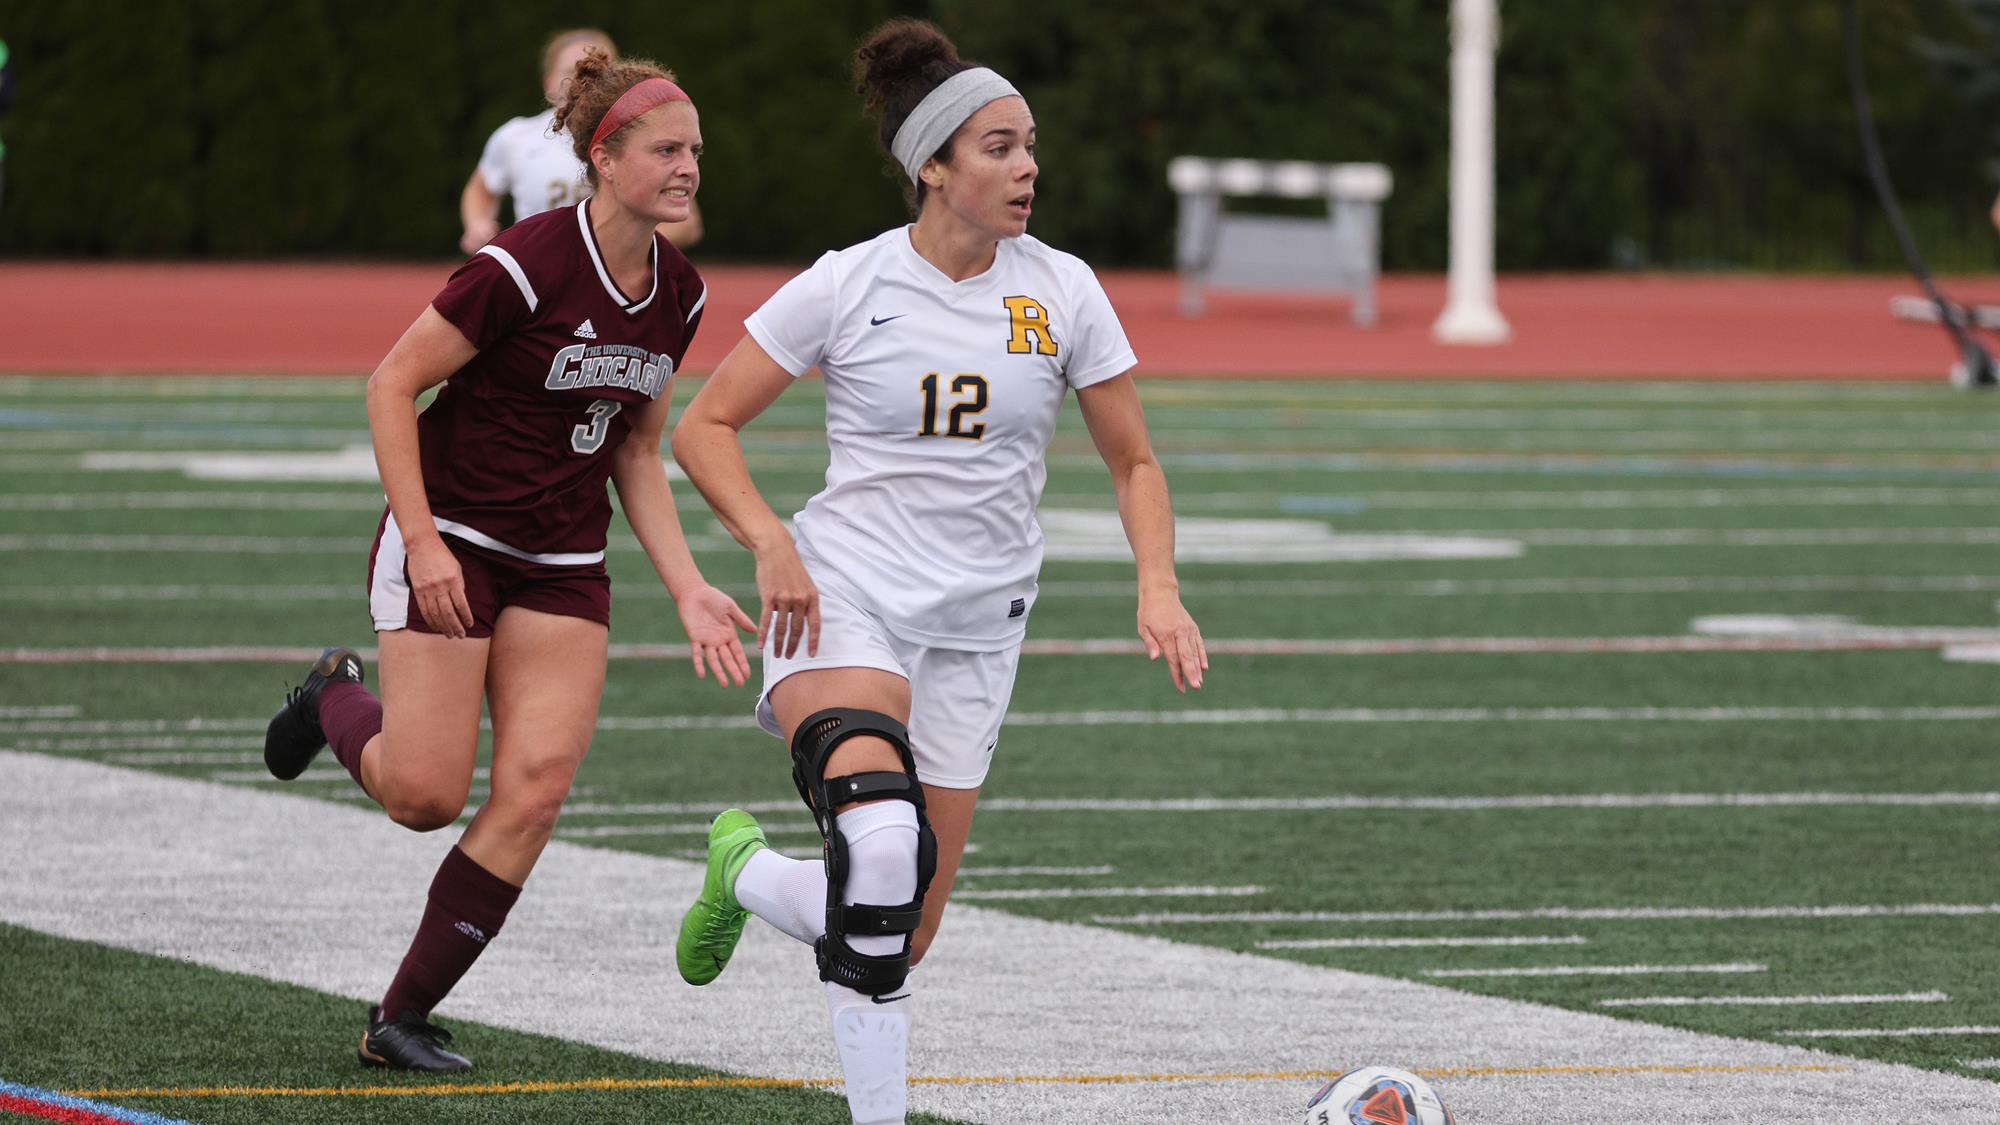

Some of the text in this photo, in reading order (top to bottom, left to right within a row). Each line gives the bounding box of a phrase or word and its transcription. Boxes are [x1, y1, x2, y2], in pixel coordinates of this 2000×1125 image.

[574, 330, 597, 339] adidas
[585, 345, 602, 358] THE
[603, 344, 648, 360] UNIVERSITY
[1003, 295, 1058, 356] R
[545, 344, 673, 400] CHICAGO
[571, 400, 622, 454] 3
[917, 372, 990, 442] 12
